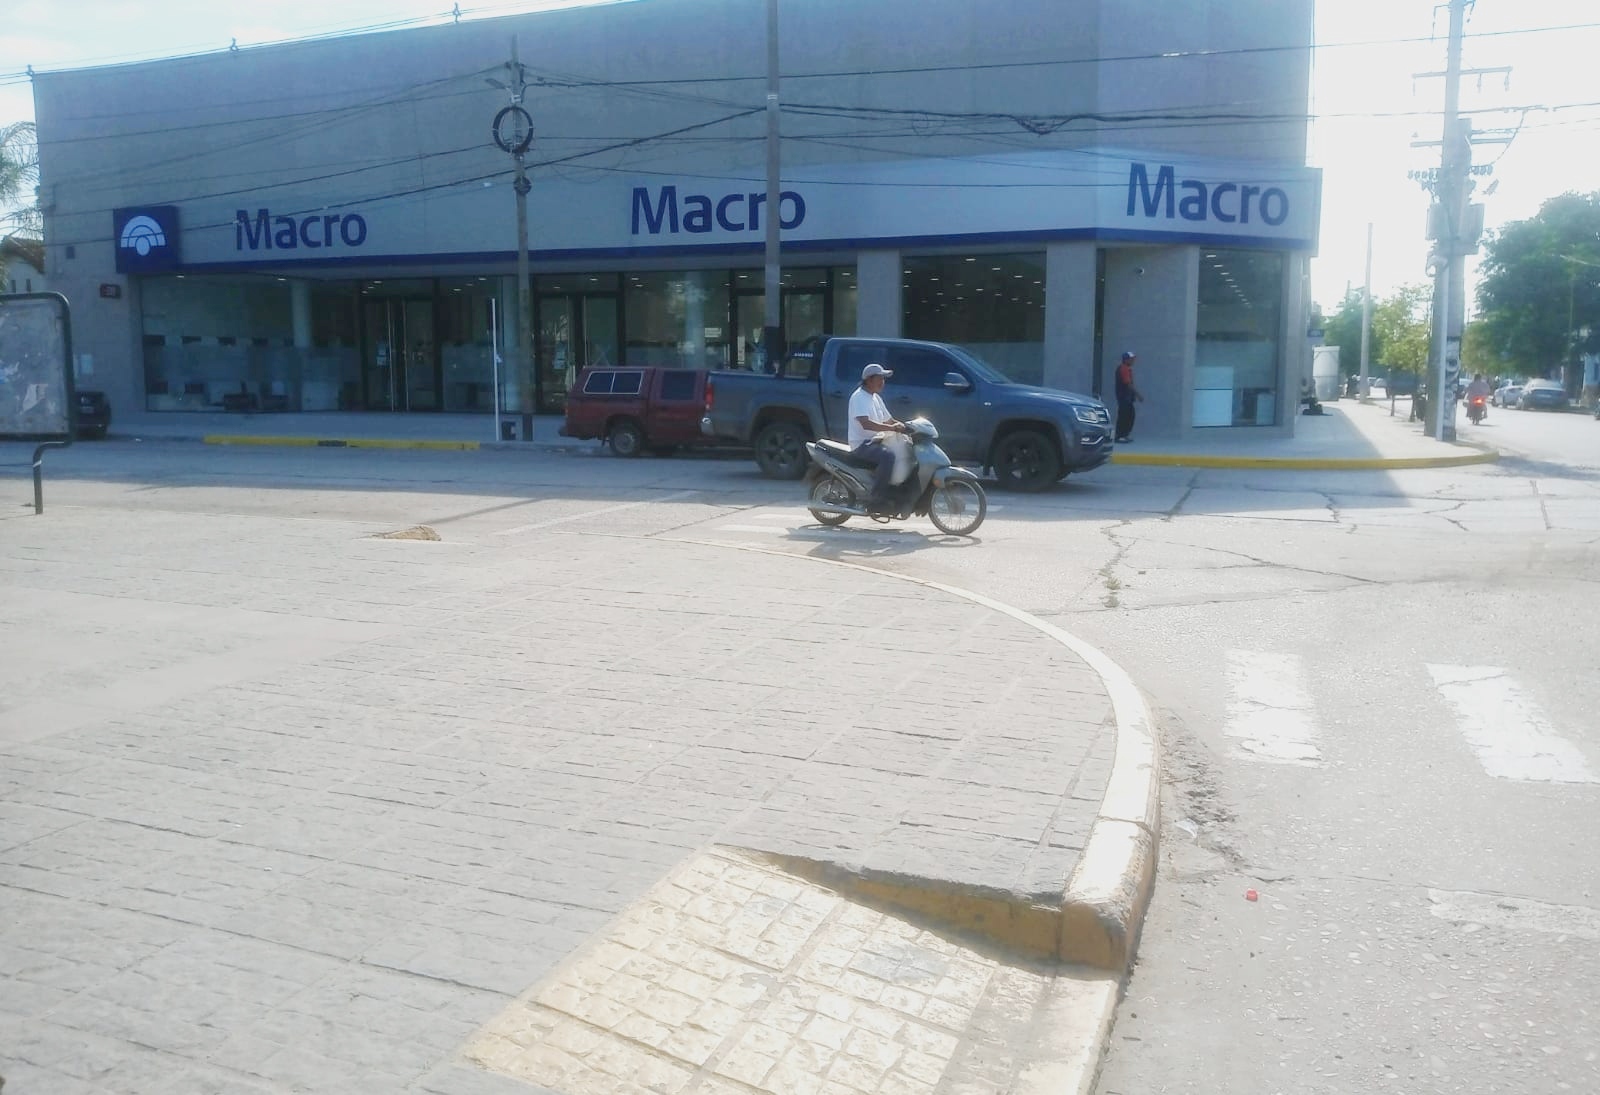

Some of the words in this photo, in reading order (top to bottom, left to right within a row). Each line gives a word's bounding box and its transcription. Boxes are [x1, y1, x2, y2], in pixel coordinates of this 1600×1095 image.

[632, 185, 806, 234] Macro
[1126, 162, 1289, 226] Macro
[236, 208, 367, 250] Macro
